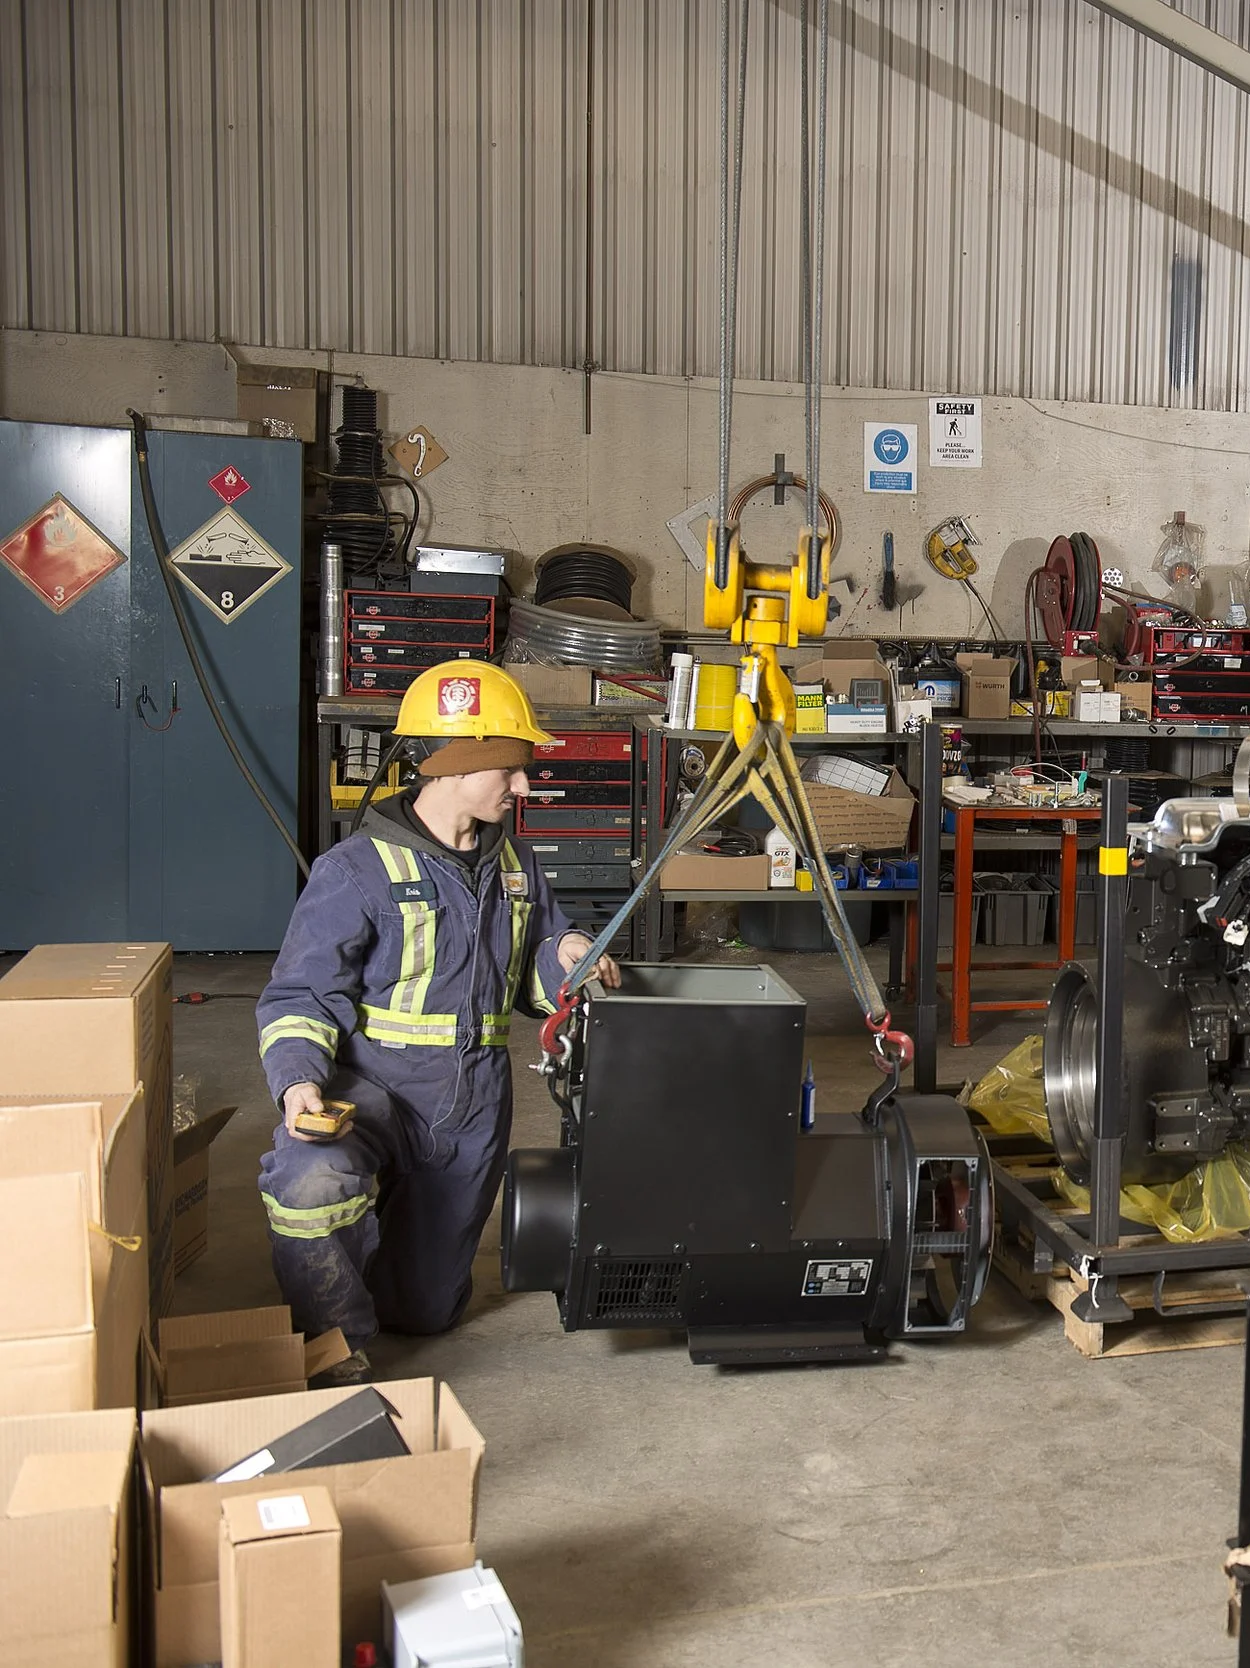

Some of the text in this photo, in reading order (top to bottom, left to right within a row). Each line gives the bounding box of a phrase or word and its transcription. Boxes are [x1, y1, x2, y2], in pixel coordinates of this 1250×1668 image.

[939, 403, 972, 411] SAFETY
[54, 585, 65, 601] 3
[221, 591, 234, 608] 8
[797, 694, 823, 702] MANN
[797, 700, 823, 708] FILTER
